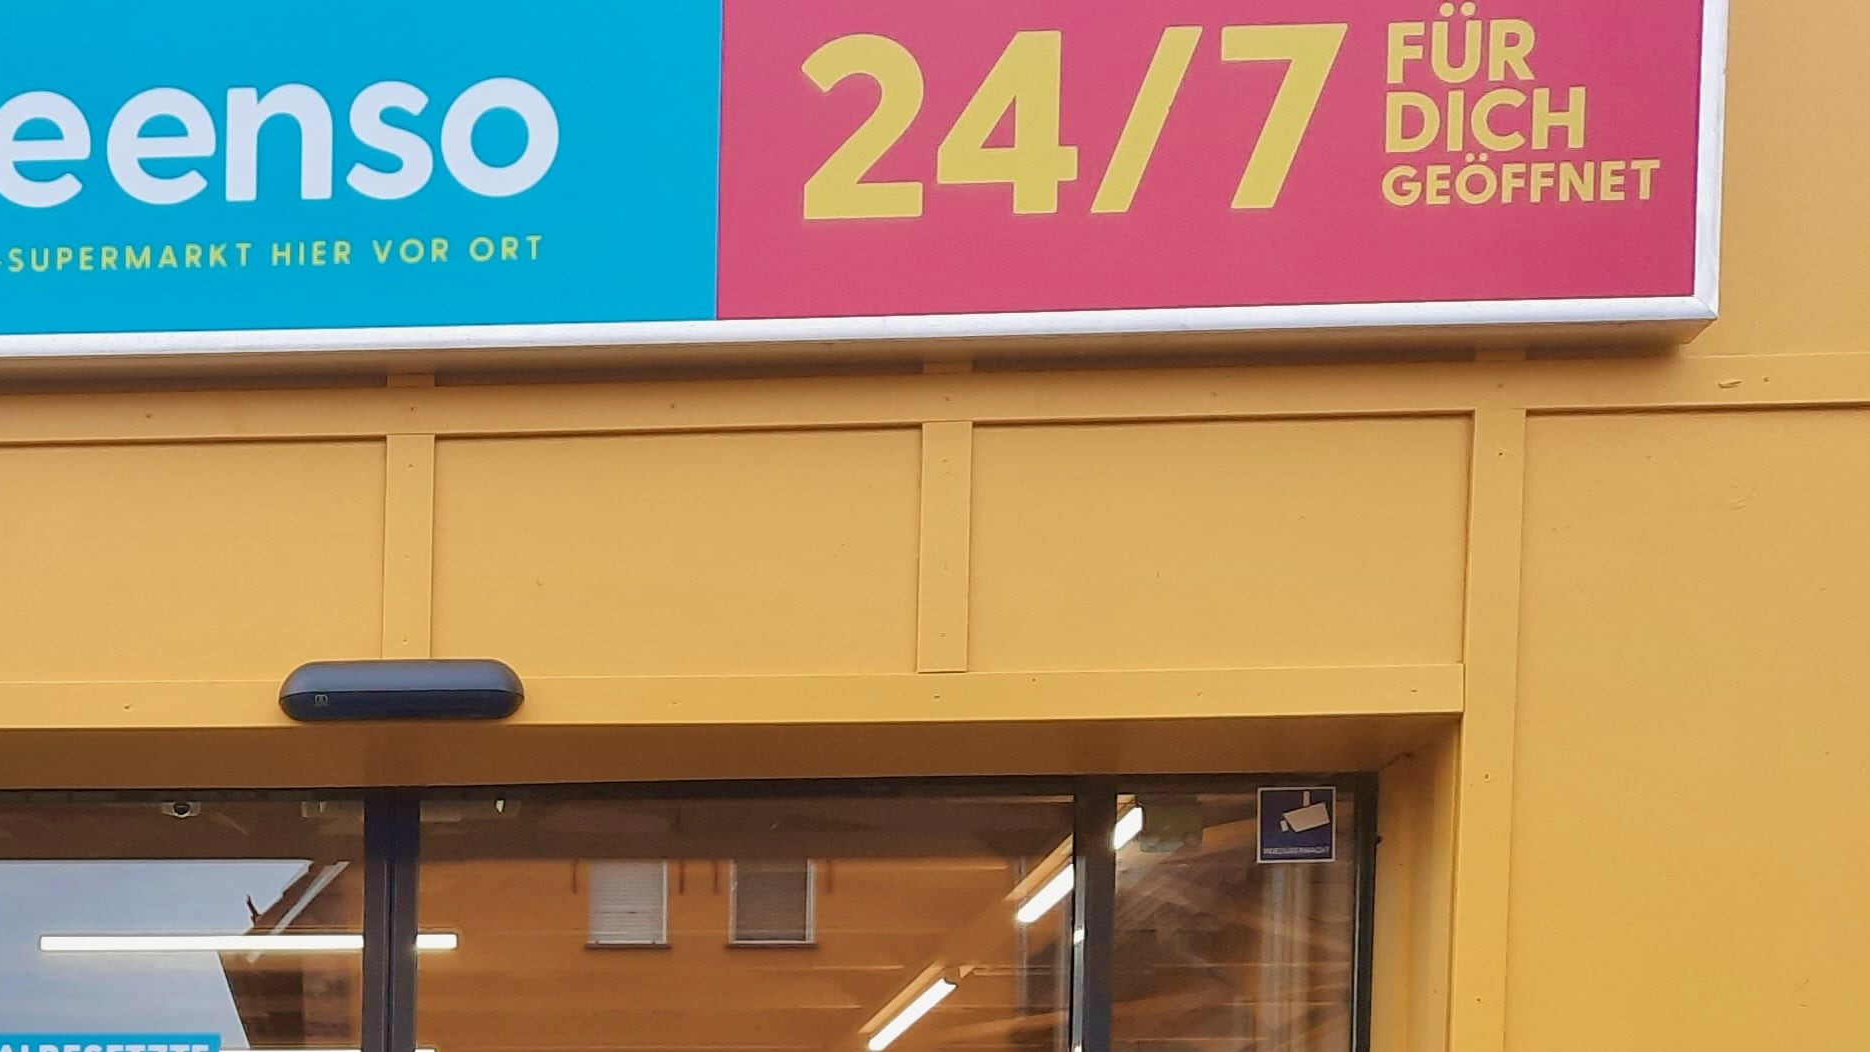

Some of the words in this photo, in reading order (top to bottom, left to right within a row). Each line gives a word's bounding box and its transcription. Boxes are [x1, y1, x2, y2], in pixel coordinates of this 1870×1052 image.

[1386, 3, 1535, 84] FÜR
[801, 24, 1347, 220] 24/7
[1385, 85, 1586, 153] DICH
[1381, 152, 1662, 206] GEÖFFNET
[271, 241, 353, 266] HIER
[372, 238, 448, 264] VOR
[468, 235, 544, 261] ORT
